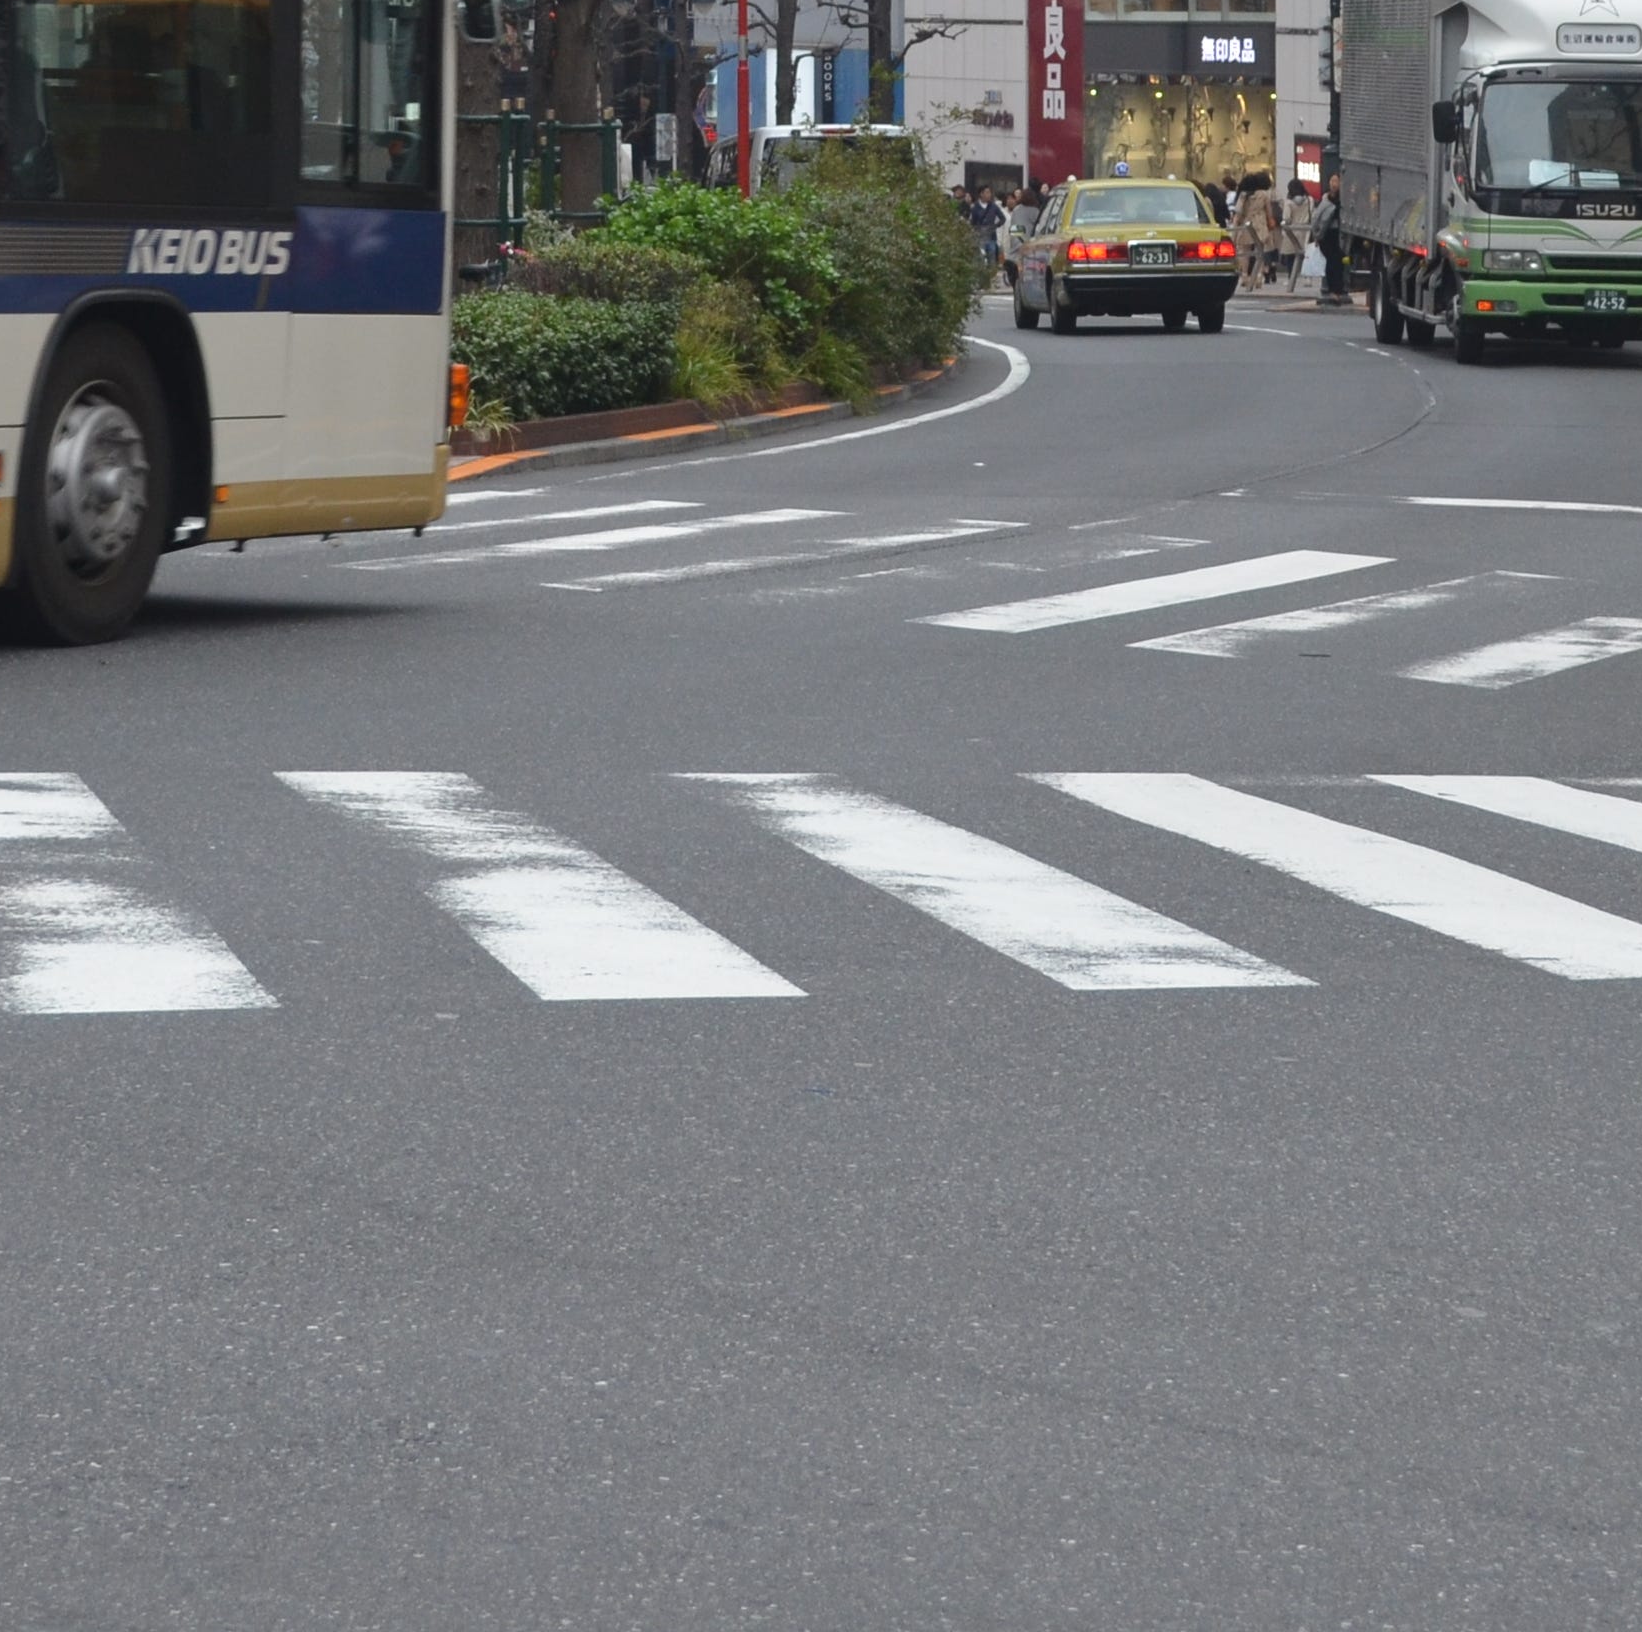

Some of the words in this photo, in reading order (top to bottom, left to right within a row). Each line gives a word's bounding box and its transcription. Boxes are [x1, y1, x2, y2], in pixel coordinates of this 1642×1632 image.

[1201, 36, 1256, 64] 無印良品
[1576, 203, 1637, 217] ISUZU
[127, 228, 215, 275] KEIO
[215, 229, 293, 275] BUS
